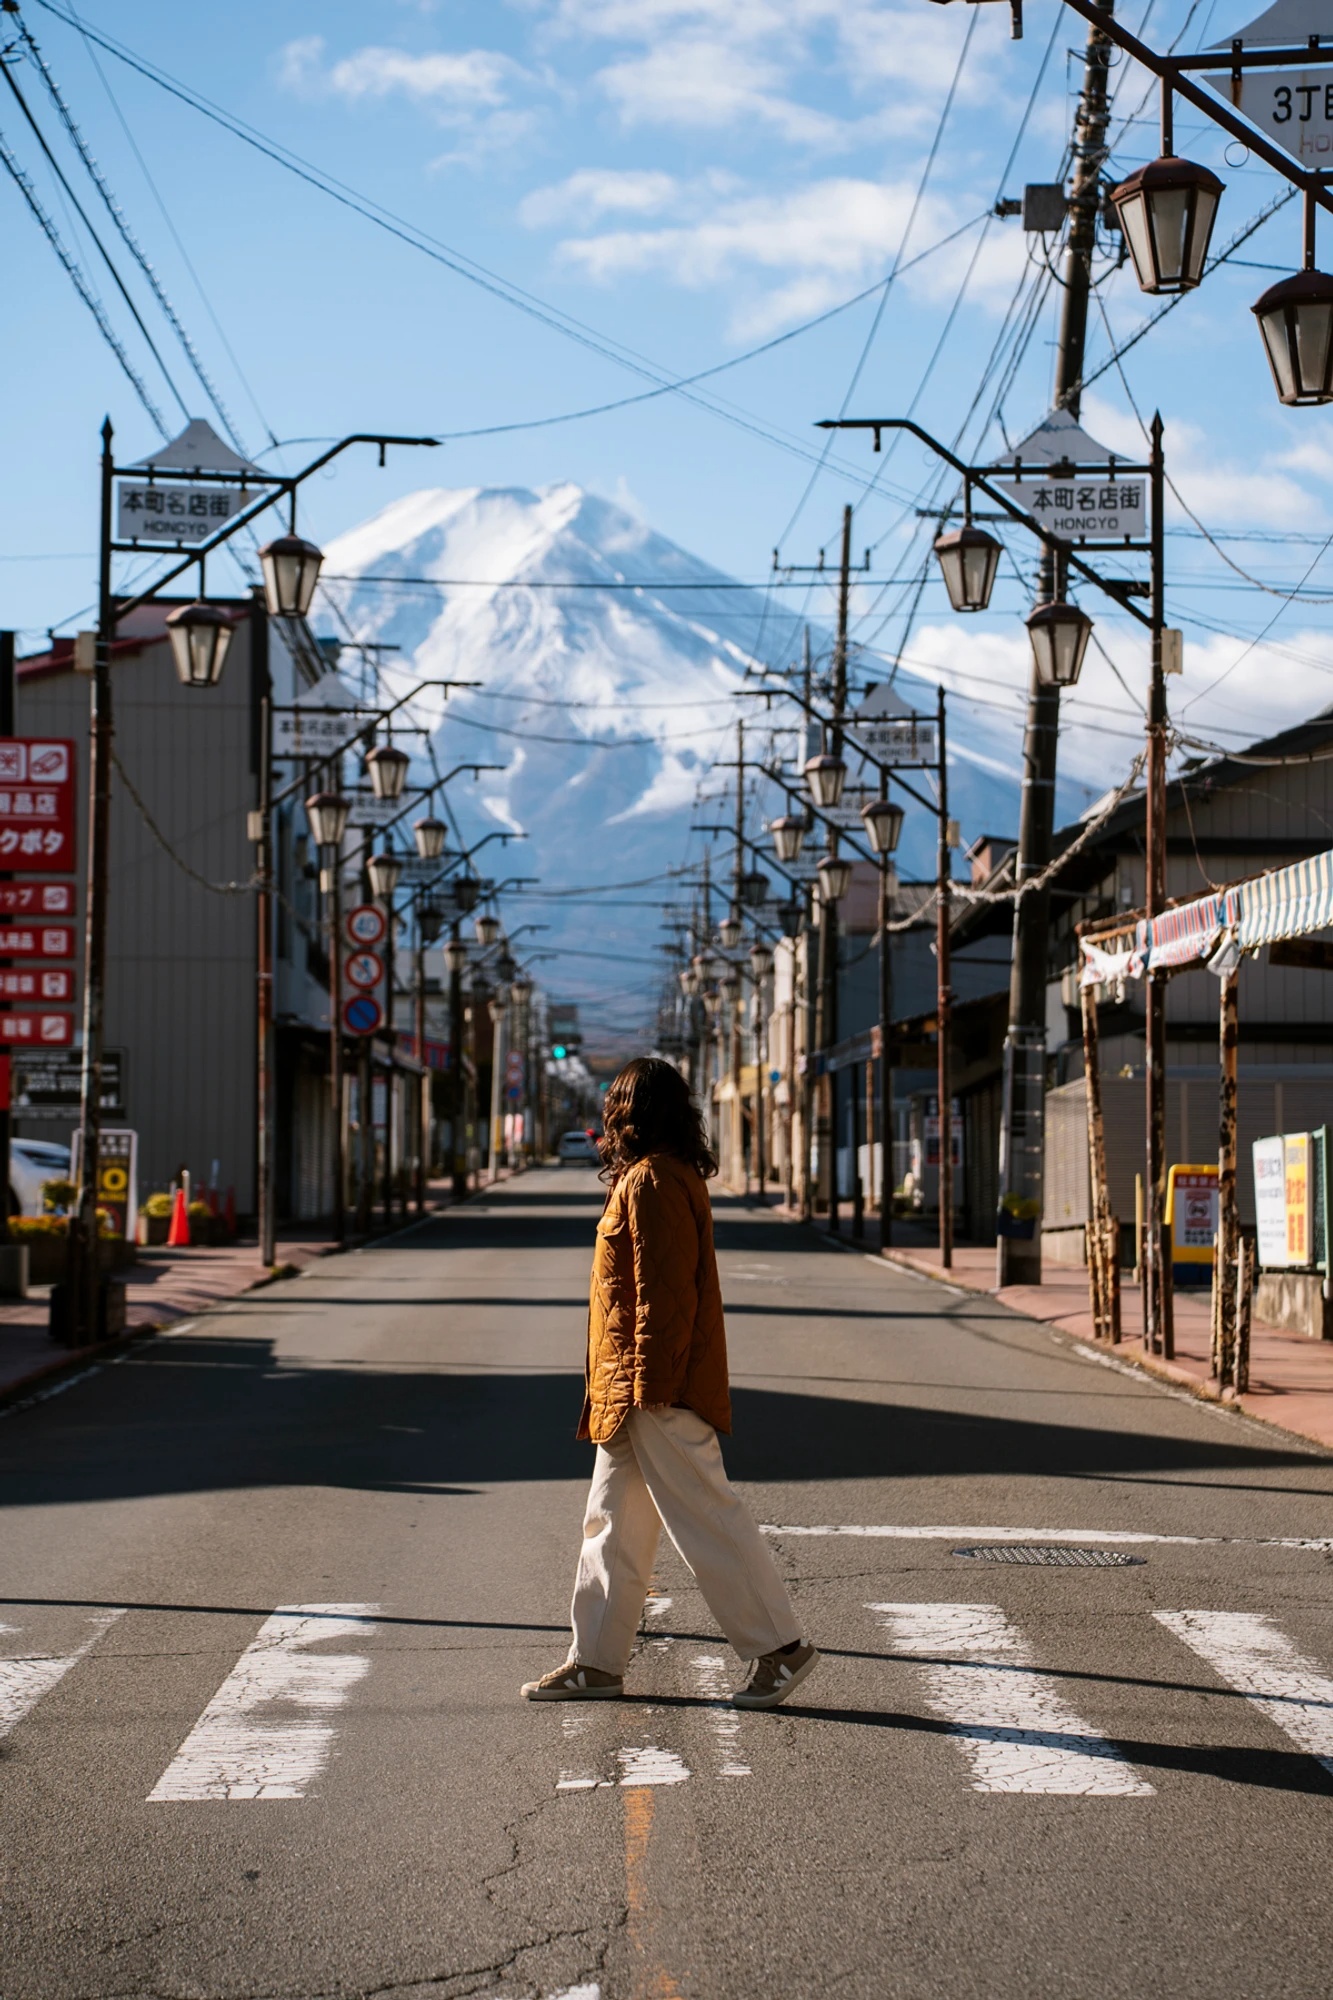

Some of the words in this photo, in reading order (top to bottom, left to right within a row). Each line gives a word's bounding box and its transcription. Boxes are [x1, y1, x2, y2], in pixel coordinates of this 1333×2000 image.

[1299, 134, 1333, 155] HO
[122, 490, 231, 517] 本町名店街
[1032, 485, 1141, 512] 本町名店街
[356, 915, 380, 935] 40
